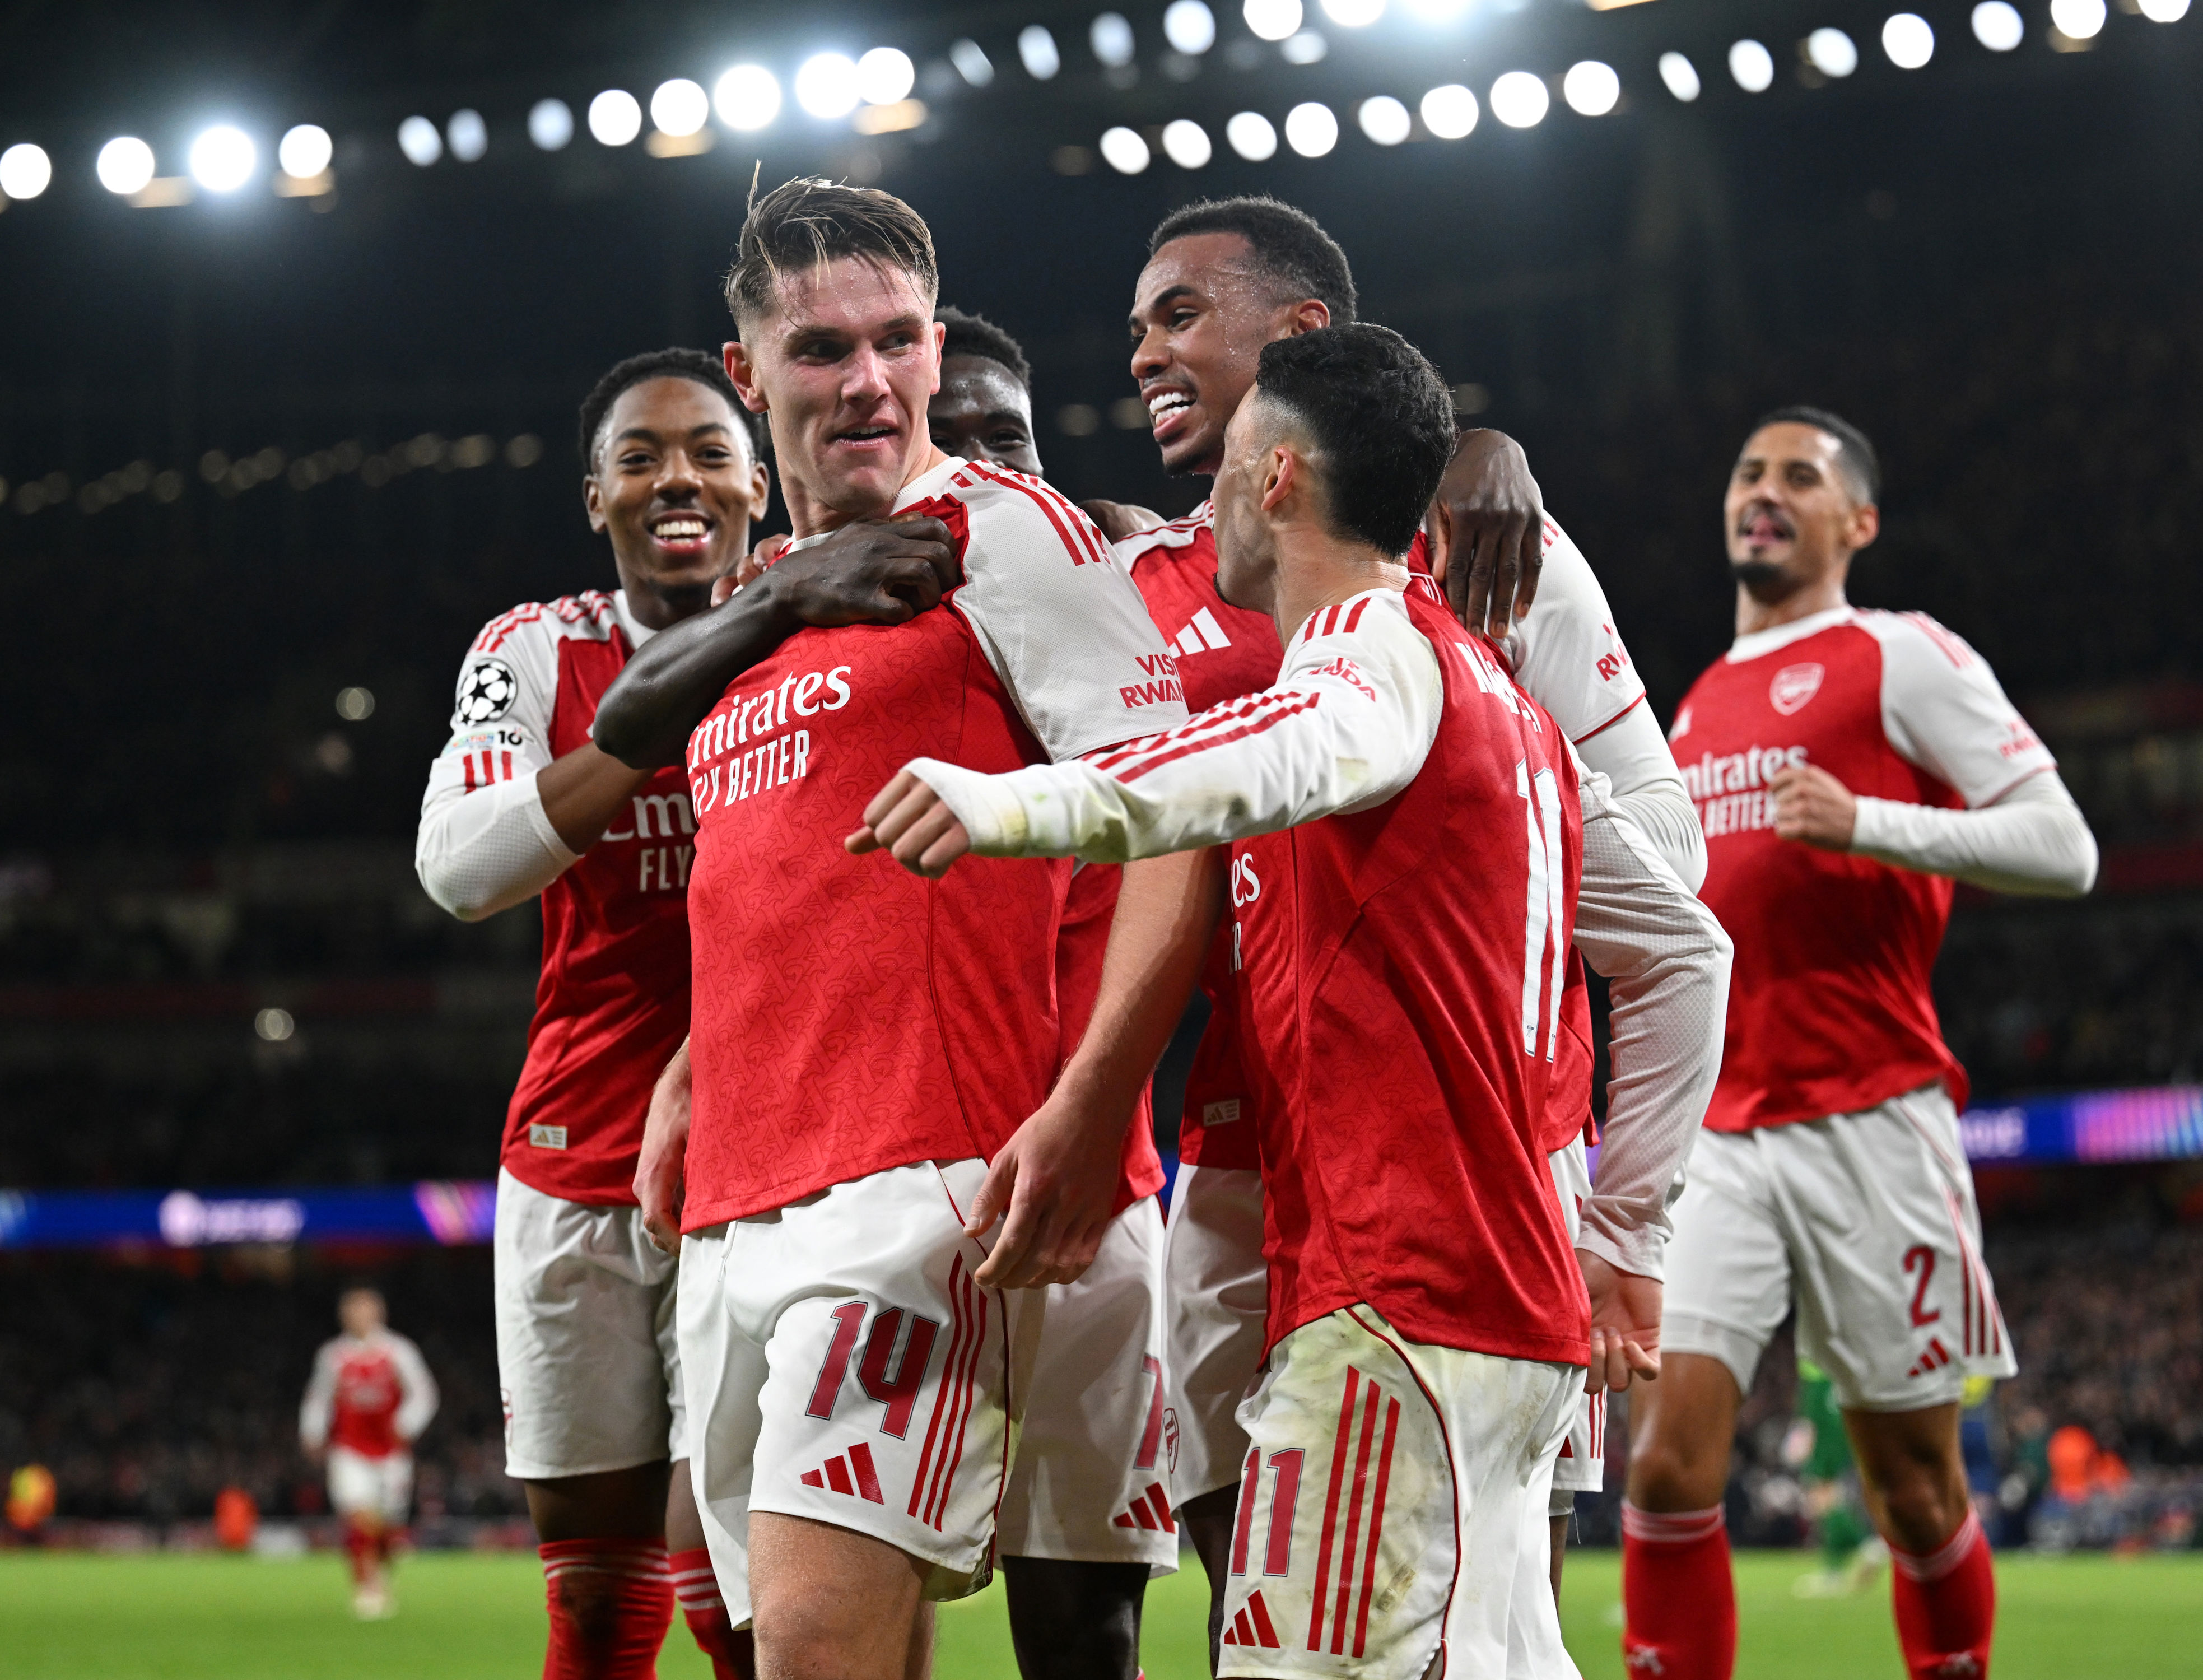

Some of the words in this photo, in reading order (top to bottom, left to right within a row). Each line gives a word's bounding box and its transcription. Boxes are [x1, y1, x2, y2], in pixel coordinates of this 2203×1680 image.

[1119, 680, 1183, 708] RWAN
[1135, 654, 1178, 677] VISI
[688, 666, 851, 774] mirates
[724, 729, 809, 807] BETTER
[640, 845, 692, 892] FLY
[1516, 756, 1563, 1063] 11
[1903, 1244, 1941, 1328] 2
[805, 1301, 939, 1441] 14
[1231, 1446, 1306, 1577] 11
